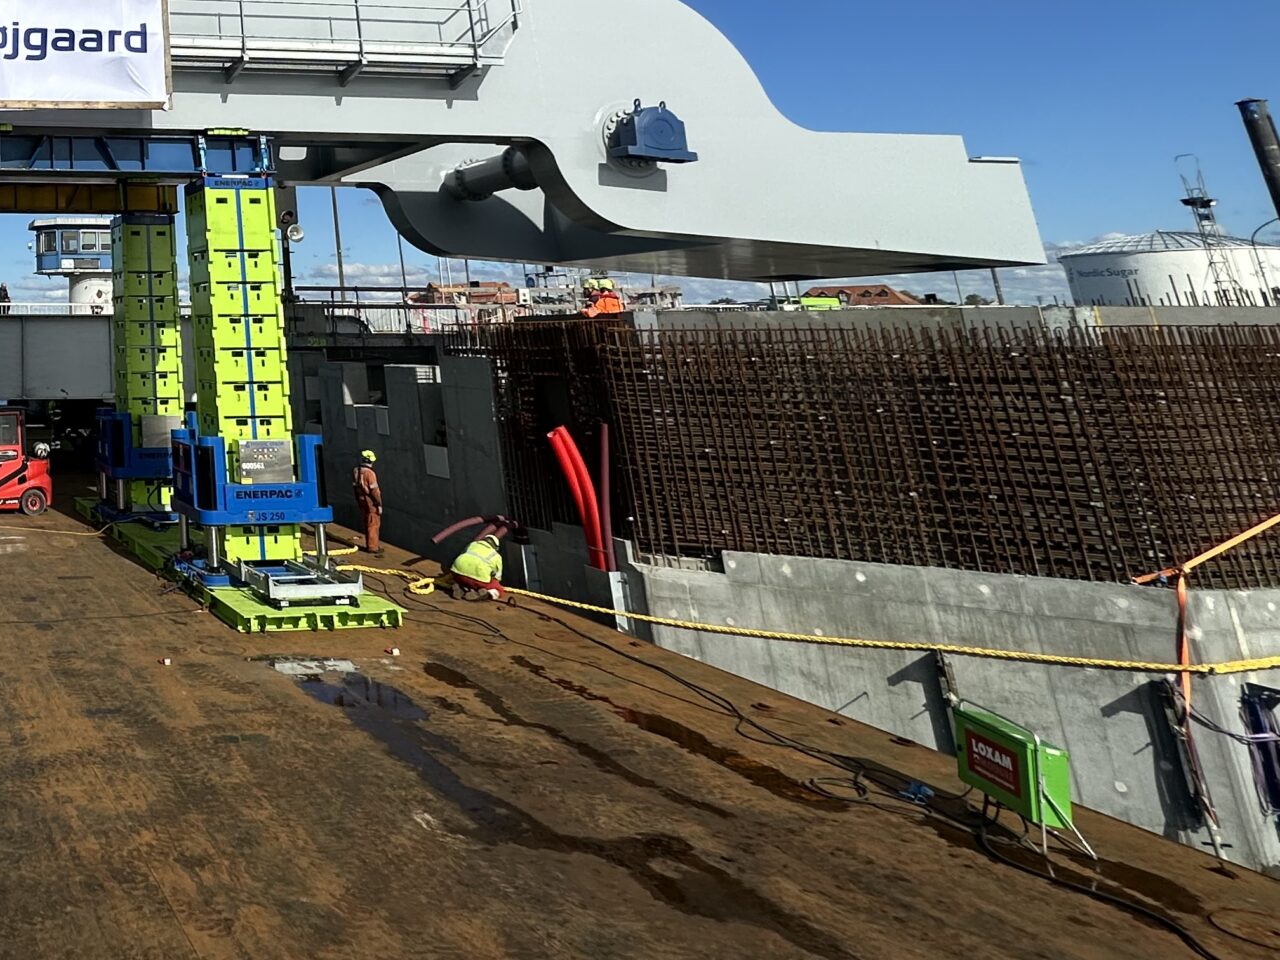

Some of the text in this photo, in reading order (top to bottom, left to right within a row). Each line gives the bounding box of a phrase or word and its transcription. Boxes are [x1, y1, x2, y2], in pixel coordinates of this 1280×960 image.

[236, 490, 293, 500] ENERPAC
[256, 512, 286, 521] JS 250
[971, 738, 1013, 771] LOXAM
